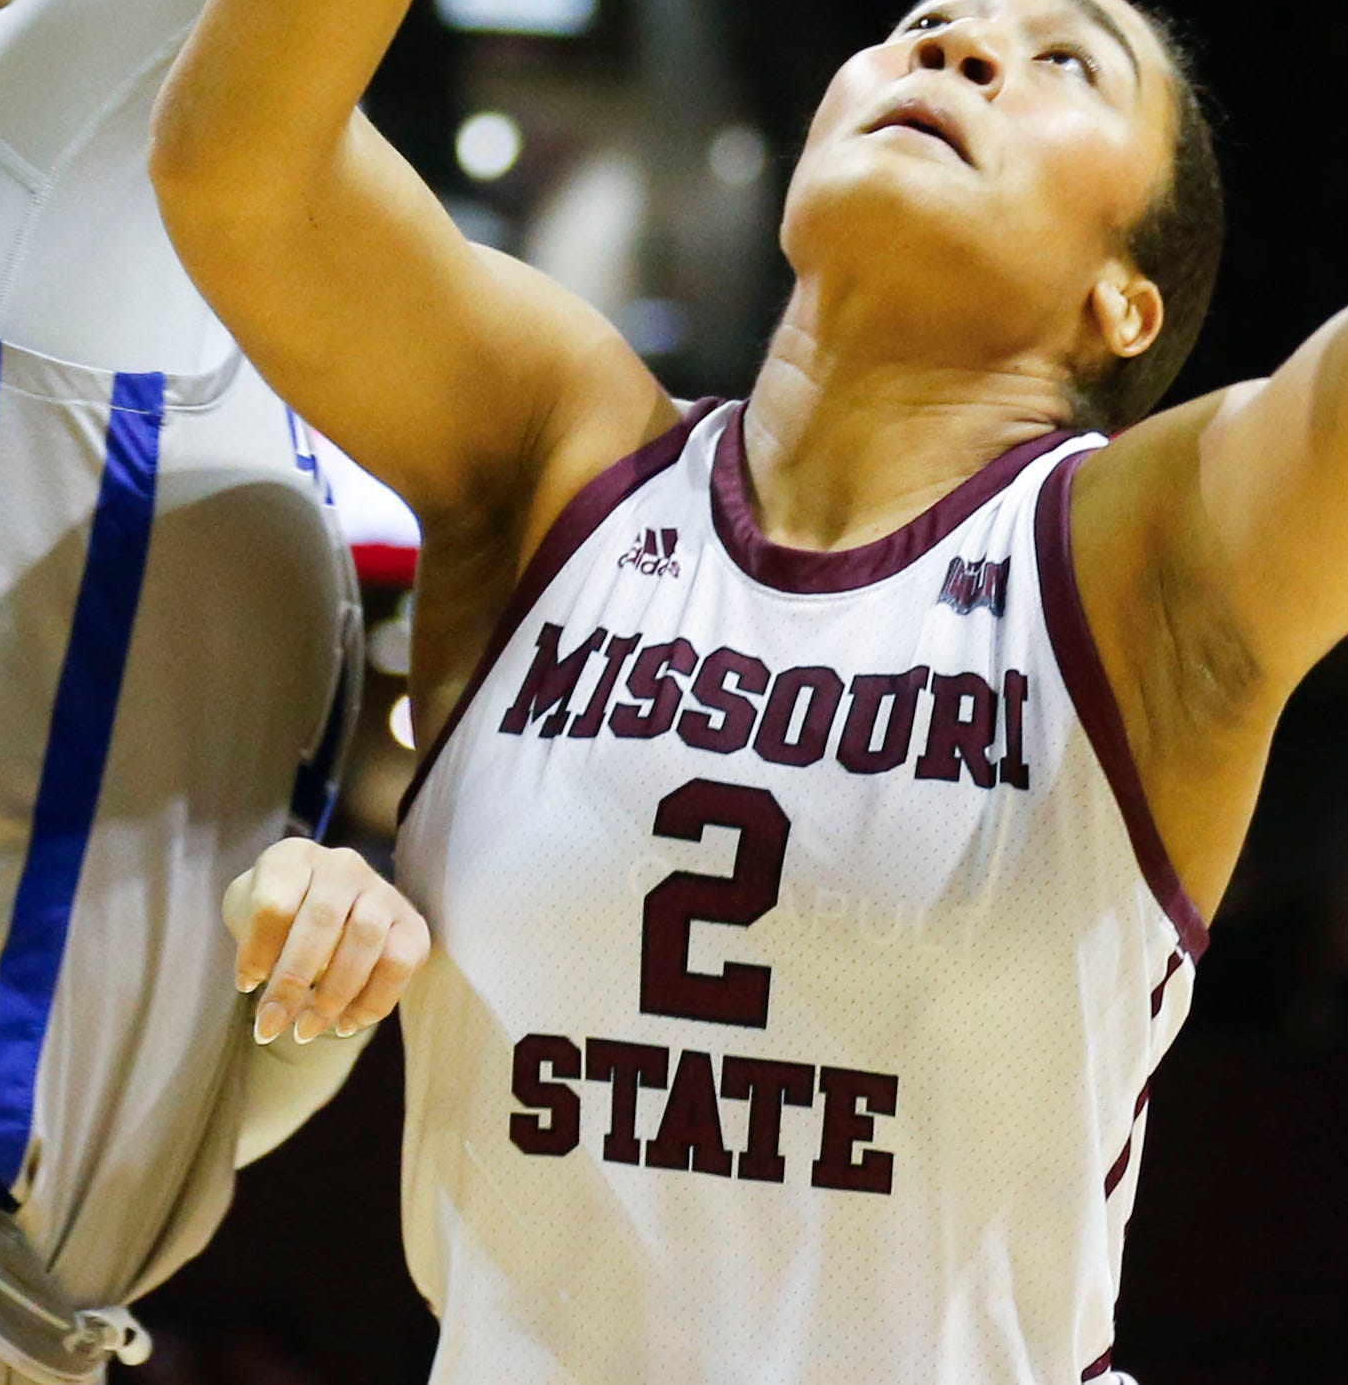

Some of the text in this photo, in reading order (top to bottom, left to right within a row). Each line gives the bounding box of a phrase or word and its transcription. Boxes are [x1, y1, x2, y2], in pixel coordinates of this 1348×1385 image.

[498, 622, 1030, 791] MISSOURI
[639, 777, 792, 1030] 2
[509, 1033, 899, 1195] STATE
